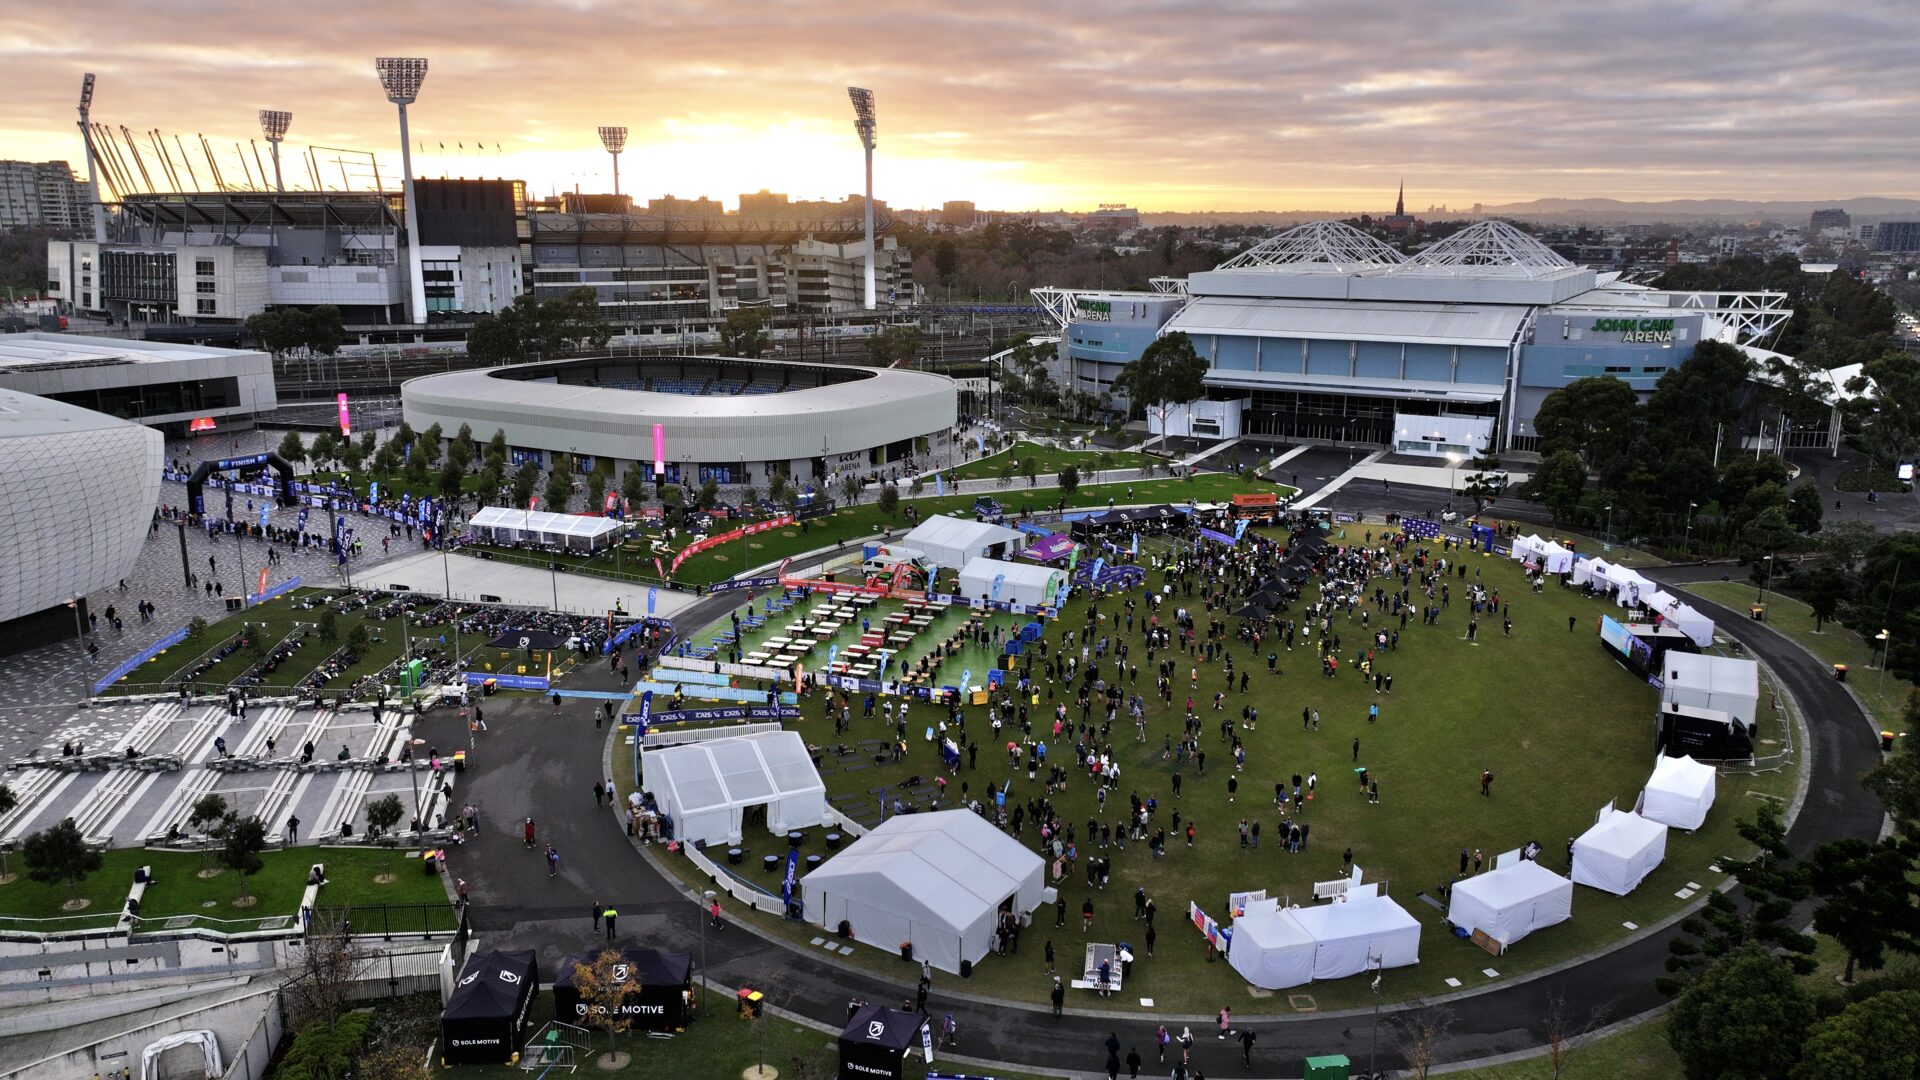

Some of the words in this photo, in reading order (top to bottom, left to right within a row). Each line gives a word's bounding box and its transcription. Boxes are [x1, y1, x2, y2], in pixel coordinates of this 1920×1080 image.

[1083, 311, 1111, 322] ARENA
[1591, 319, 1637, 331] JOHN
[1640, 319, 1675, 331] CAIN
[1621, 331, 1674, 342] ARENA
[231, 459, 256, 467] FINISH
[841, 463, 861, 471] ARENA
[592, 1005, 619, 1014] SOE
[622, 1005, 664, 1014] MOTIVE
[854, 1064, 869, 1073] SOLE
[869, 1067, 893, 1077] MOTIVE
